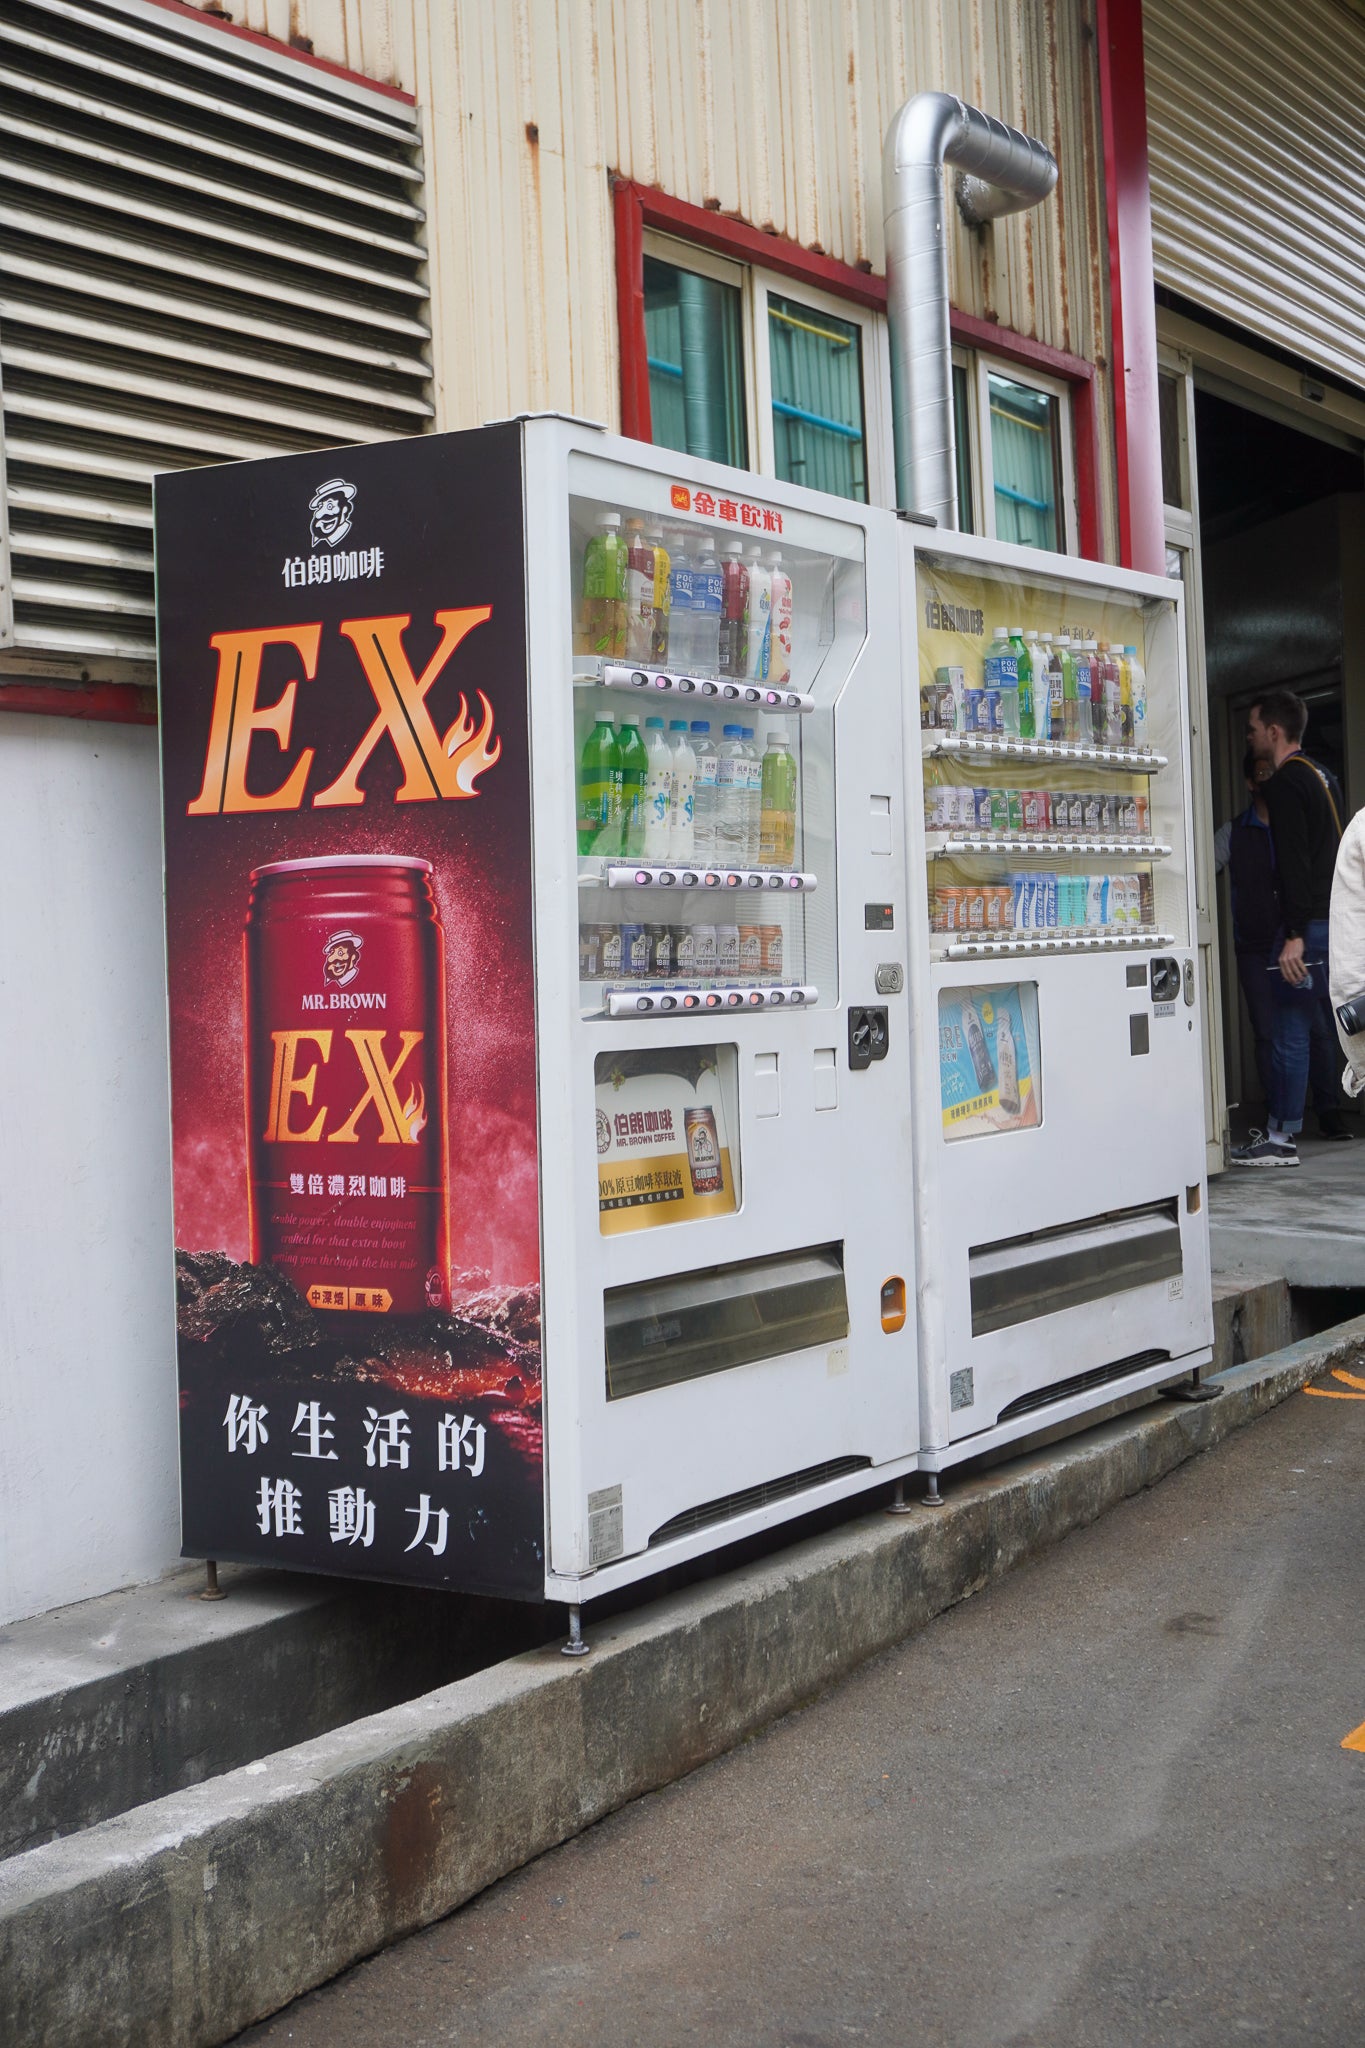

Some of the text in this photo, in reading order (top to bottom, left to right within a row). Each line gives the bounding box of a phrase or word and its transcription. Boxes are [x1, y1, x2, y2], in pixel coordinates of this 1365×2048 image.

[692, 491, 784, 534] 金車飲料
[281, 547, 385, 588] 伯朗咖啡
[925, 601, 984, 636] 伯朗咖啡
[186, 604, 500, 816] EX
[301, 993, 387, 1011] MR.BROWN
[263, 1029, 427, 1144] EX
[614, 1109, 674, 1136] 伯朗咖啡
[616, 1132, 676, 1147] MR. BROWN COFFEE
[289, 1173, 407, 1199] 雙倍濃烈咖啡
[334, 1215, 371, 1229] double
[311, 1234, 327, 1247] for
[328, 1234, 350, 1247] that
[351, 1237, 379, 1249] extra
[381, 1237, 407, 1250] boost
[300, 1257, 318, 1268] you
[319, 1254, 359, 1271] through
[362, 1256, 377, 1268] the
[379, 1257, 397, 1269] last
[311, 1289, 384, 1308] 中深焙 原味
[222, 1393, 487, 1478] 你生活的
[255, 1476, 450, 1556] 推動力
